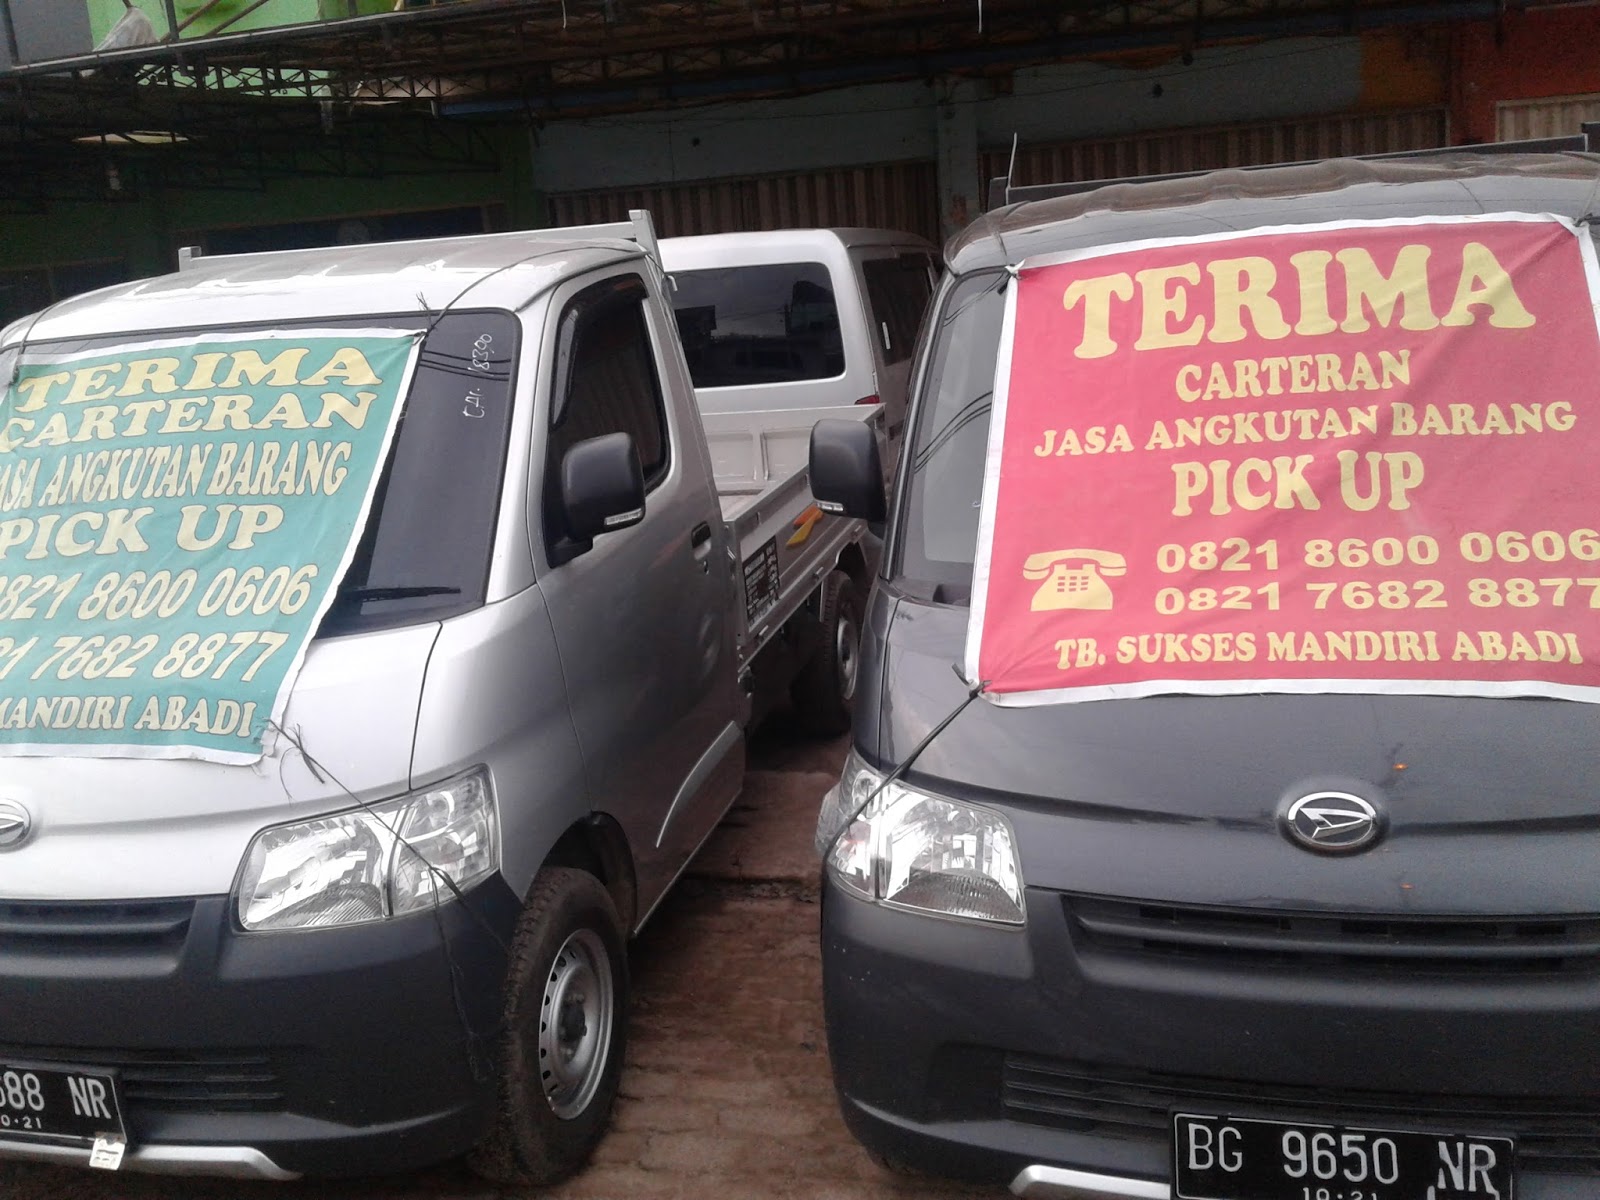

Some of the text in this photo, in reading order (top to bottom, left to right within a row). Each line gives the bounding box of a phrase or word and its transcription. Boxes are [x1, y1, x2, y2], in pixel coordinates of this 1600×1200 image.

[1063, 242, 1537, 360] TERIMA
[14, 347, 383, 413] TERIMA
[1175, 349, 1411, 402] CARTERAN
[0, 392, 378, 453] CARTERAN
[1034, 401, 1577, 457] JASA ANGKUTAN BARANG
[38, 444, 210, 508] ANGKUTAN
[206, 440, 352, 497] BARANG
[1171, 450, 1425, 516] PICK UP
[0, 503, 285, 560] PICK UP
[1155, 529, 1600, 574] 0821 8600 0606
[77, 569, 199, 620] 8600
[198, 564, 319, 617] 0606
[1154, 577, 1600, 615] 0821 7682 8877
[30, 634, 159, 680] 7682
[152, 631, 289, 682] 8877
[1055, 630, 1583, 669] TB. SUKSES MANDIRI ABADI
[133, 696, 258, 738] ABADI
[67, 1076, 112, 1119] NR
[1188, 1123, 1497, 1195] BG 9650 NR
